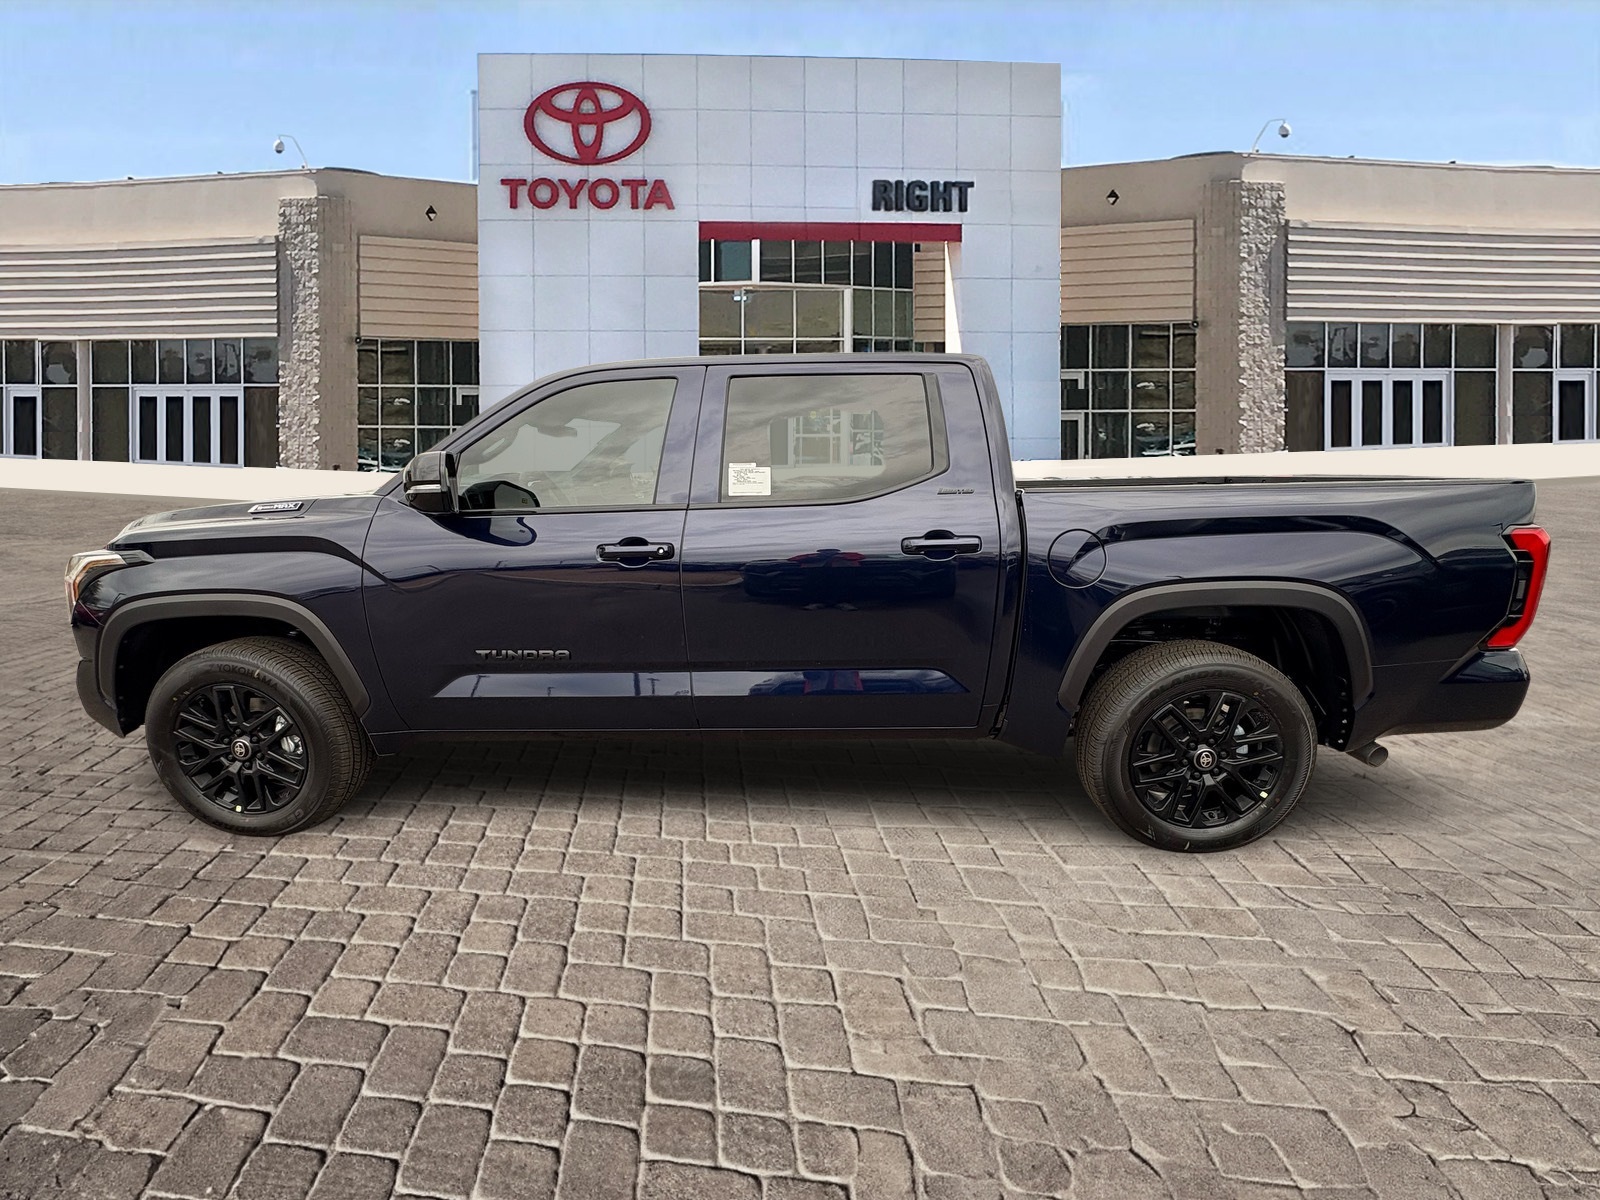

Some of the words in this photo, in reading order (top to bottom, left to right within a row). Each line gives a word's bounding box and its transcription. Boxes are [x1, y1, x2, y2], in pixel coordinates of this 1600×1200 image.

[500, 179, 676, 210] TOYOTA
[871, 180, 975, 212] RIGHT
[475, 649, 571, 660] TUNDRA
[216, 663, 279, 690] YOKOHAMA
